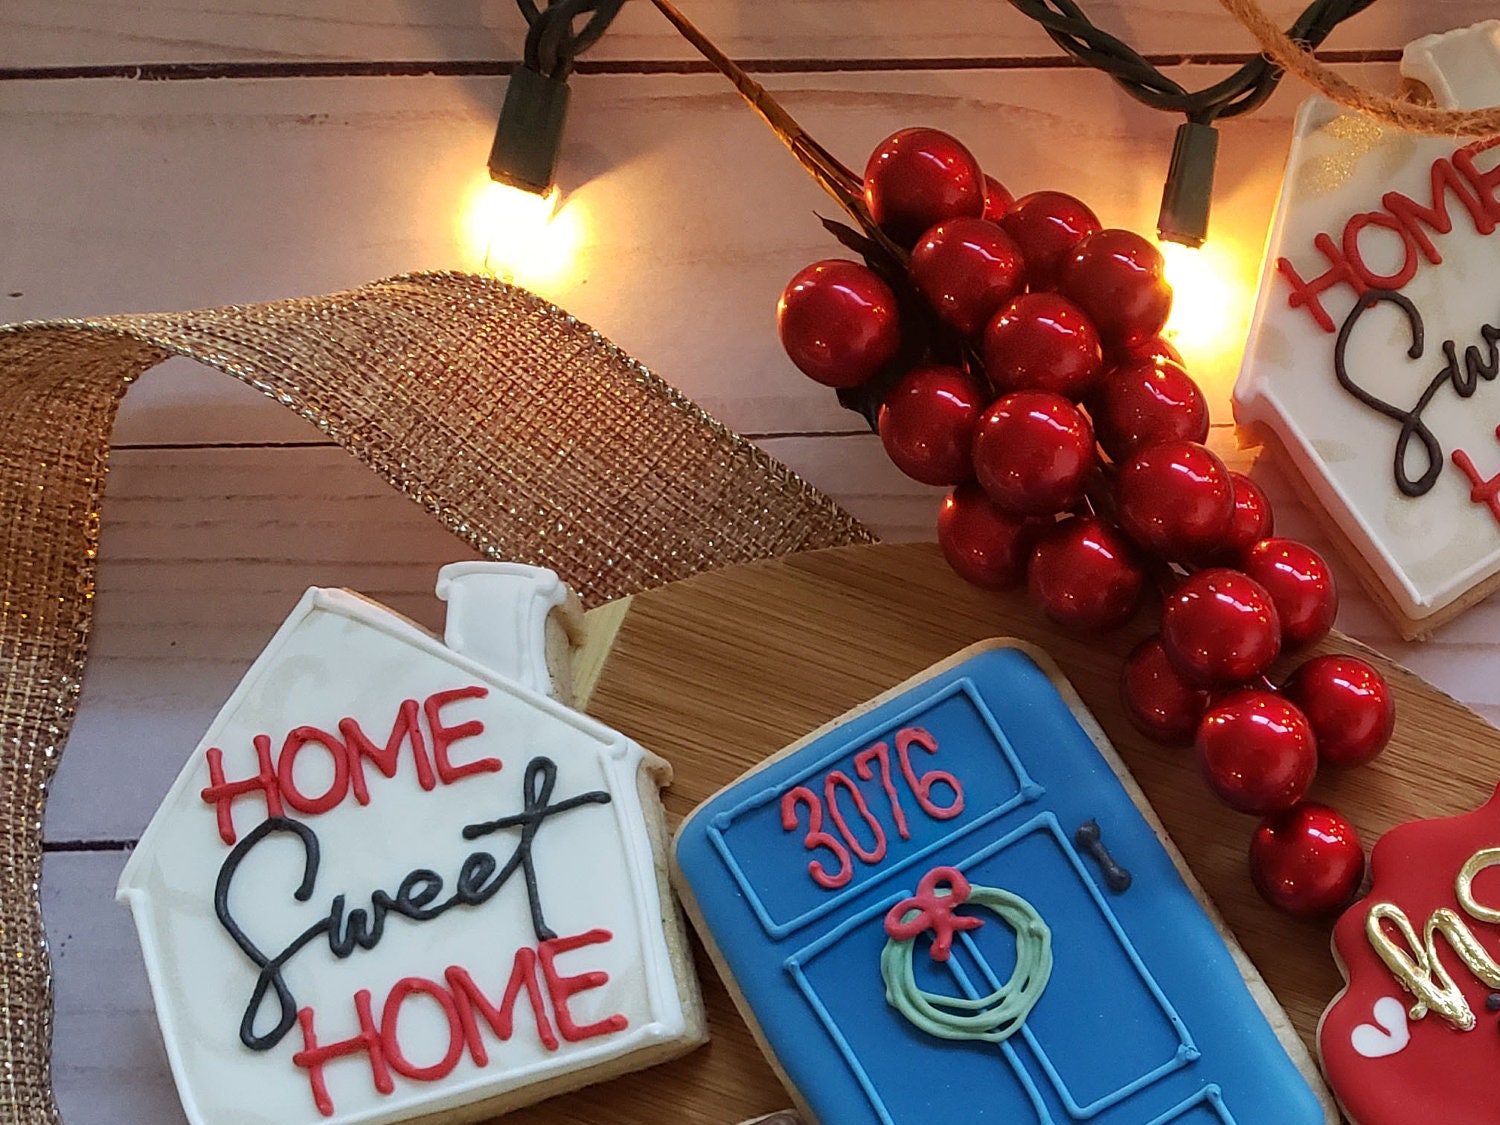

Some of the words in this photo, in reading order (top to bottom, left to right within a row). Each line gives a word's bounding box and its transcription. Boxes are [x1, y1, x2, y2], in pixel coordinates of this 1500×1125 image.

[201, 686, 502, 845] HOME
[780, 726, 964, 889] 3076
[214, 756, 611, 1051] Sweet
[292, 929, 628, 1117] HOME
